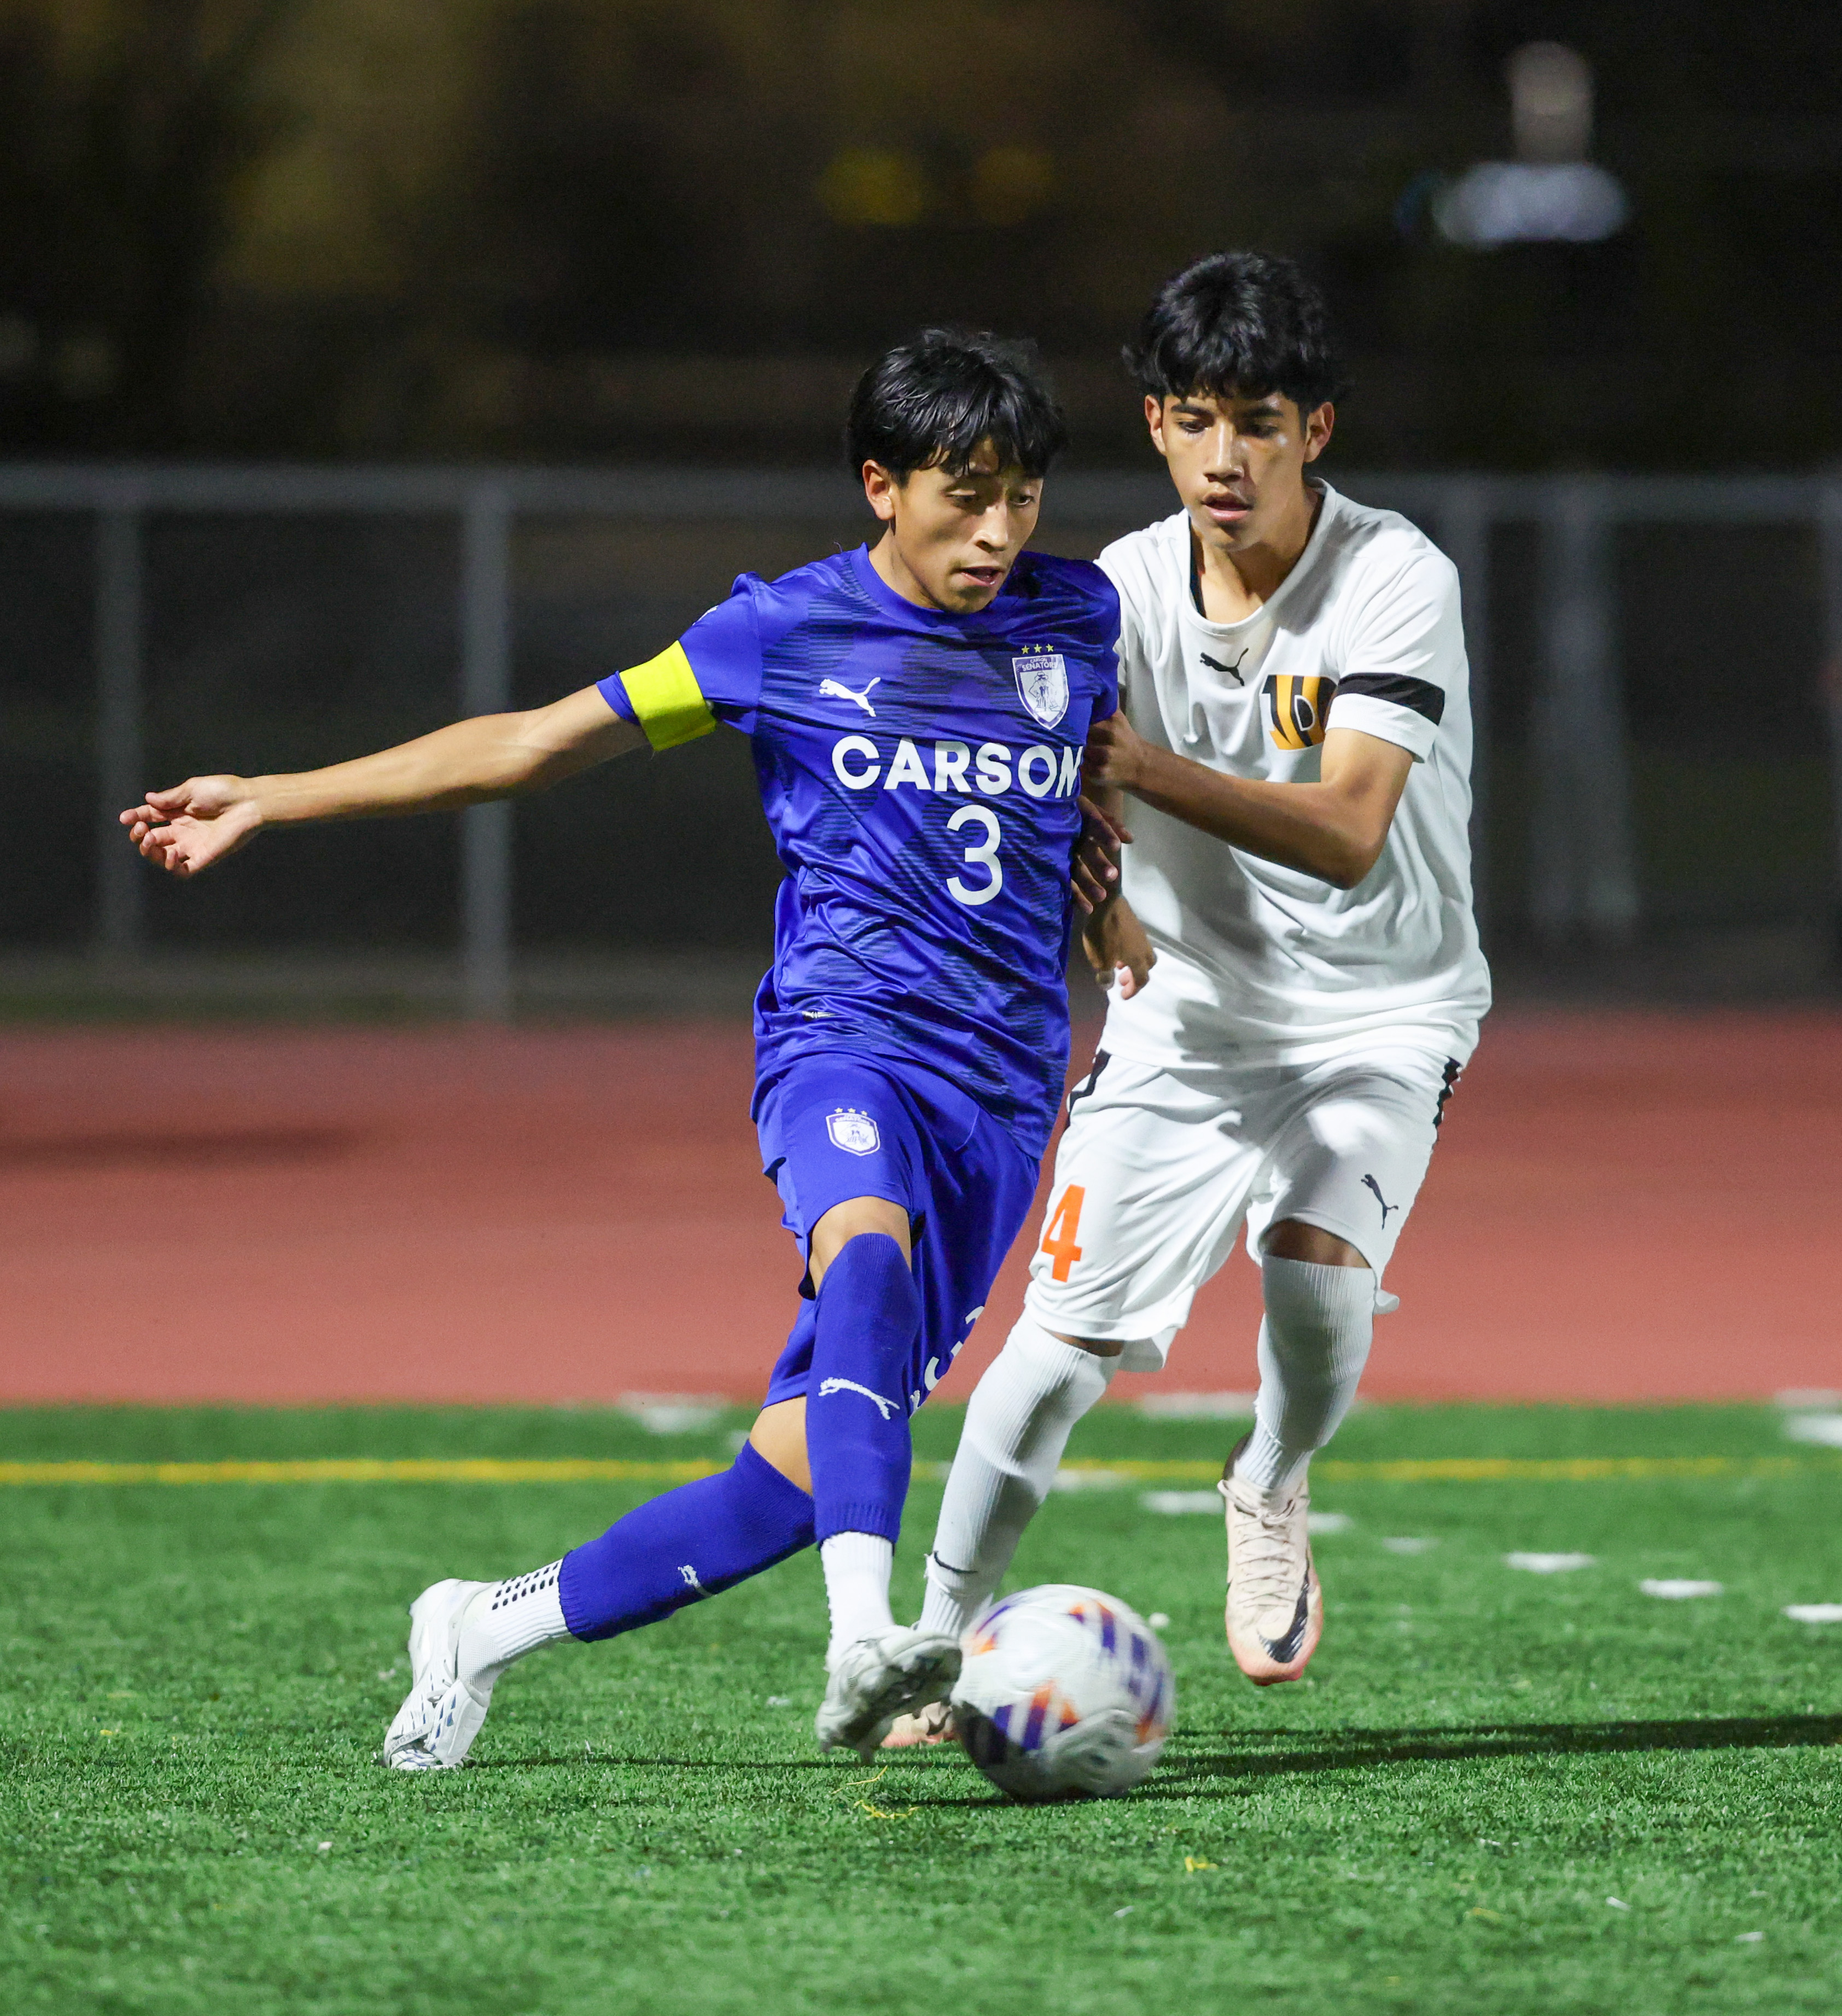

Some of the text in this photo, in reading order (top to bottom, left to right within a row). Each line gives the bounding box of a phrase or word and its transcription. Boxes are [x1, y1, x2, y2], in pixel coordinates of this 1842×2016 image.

[832, 736, 1083, 798] CARSON
[947, 805, 1003, 906] 3
[1041, 1184, 1085, 1283] 4
